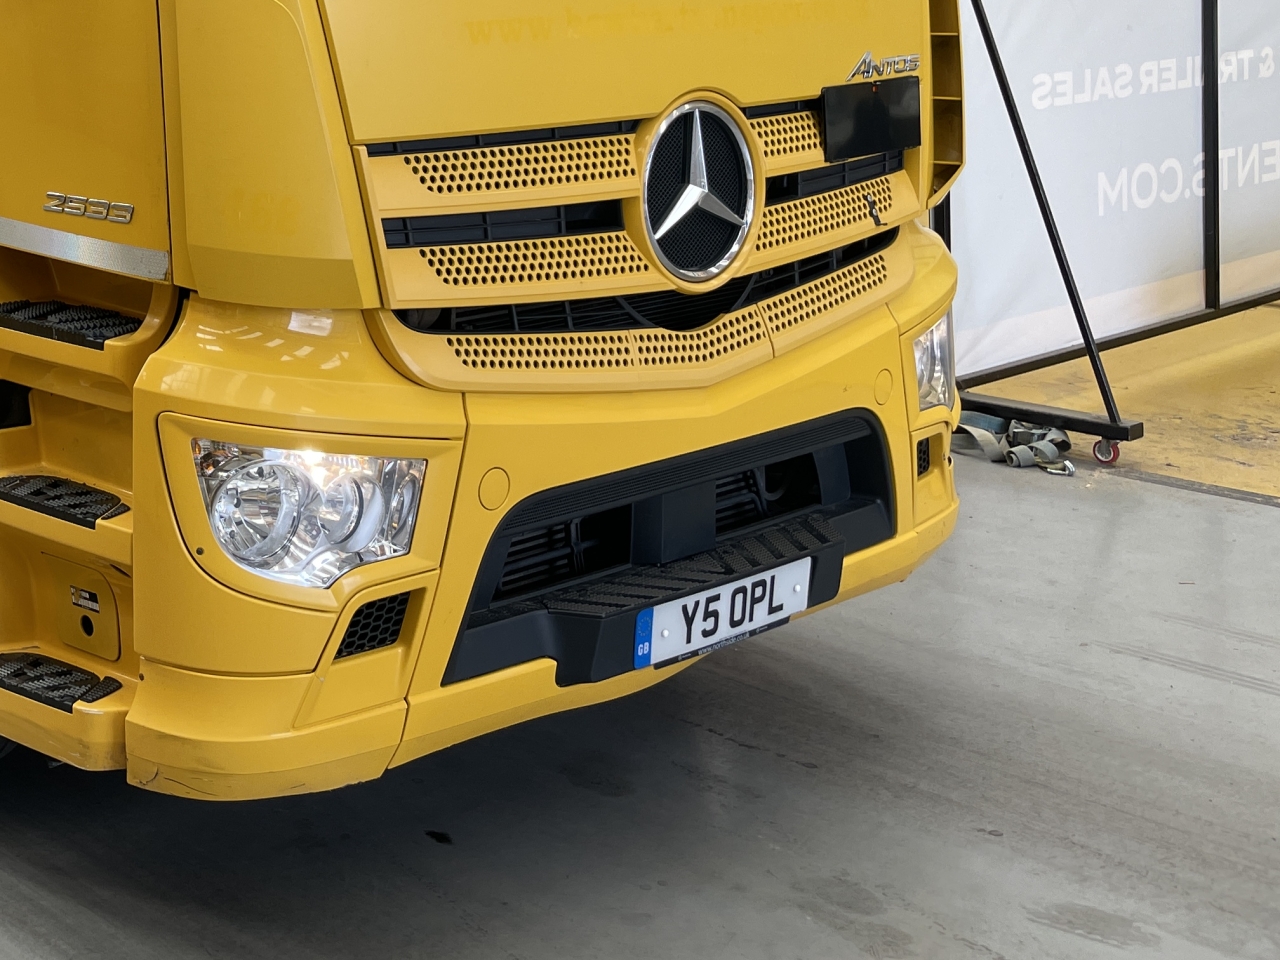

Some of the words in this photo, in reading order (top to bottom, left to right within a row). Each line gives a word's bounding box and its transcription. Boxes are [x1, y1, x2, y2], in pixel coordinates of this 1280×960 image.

[42, 191, 135, 224] 2533
[681, 593, 722, 645] Y5
[729, 574, 784, 629] OPL
[637, 641, 650, 656] GB
